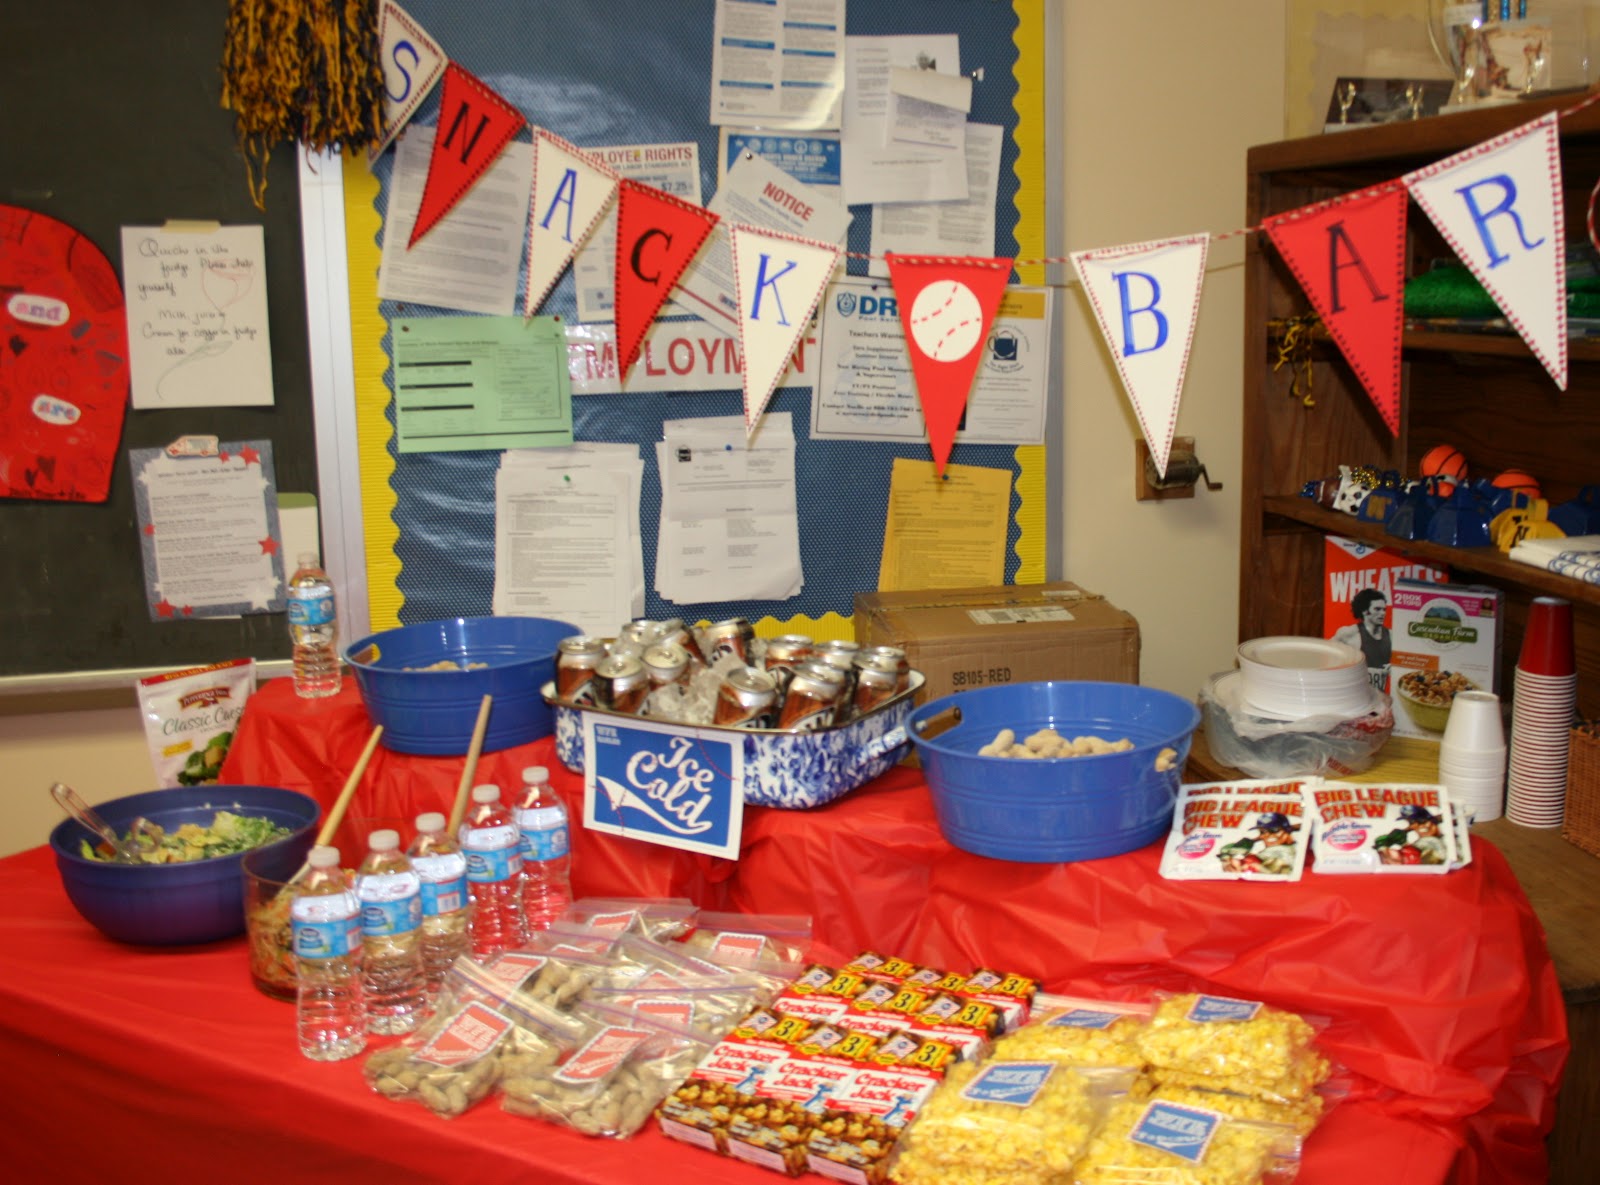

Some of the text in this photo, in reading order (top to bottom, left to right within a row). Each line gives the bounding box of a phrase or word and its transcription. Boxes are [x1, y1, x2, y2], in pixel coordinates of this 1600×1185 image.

[645, 147, 693, 162] RIGHTS
[763, 181, 815, 222] NOTICE
[15, 302, 62, 322] and
[860, 296, 900, 316] DR
[881, 332, 906, 340] Wante
[37, 401, 76, 421] are
[1330, 564, 1448, 606] WHEATI
[1394, 593, 1402, 605] 2
[953, 668, 1011, 687] SB105-RED
[163, 706, 245, 736] Classic Caes
[658, 737, 714, 793] Ice
[626, 750, 713, 828] Cold
[1314, 789, 1440, 808] BIG LEAGUE
[1184, 800, 1303, 819] BIG LEAGUE
[1321, 803, 1386, 824] CHEW
[1183, 813, 1244, 836] CHEW
[773, 1001, 842, 1017] Cracker
[713, 1045, 782, 1063] Cracker
[708, 1056, 749, 1072] Jack
[779, 1062, 848, 1081] Cracker
[773, 1074, 818, 1090] Jack
[855, 1073, 927, 1092] Cracker
[850, 1086, 895, 1102] Jack
